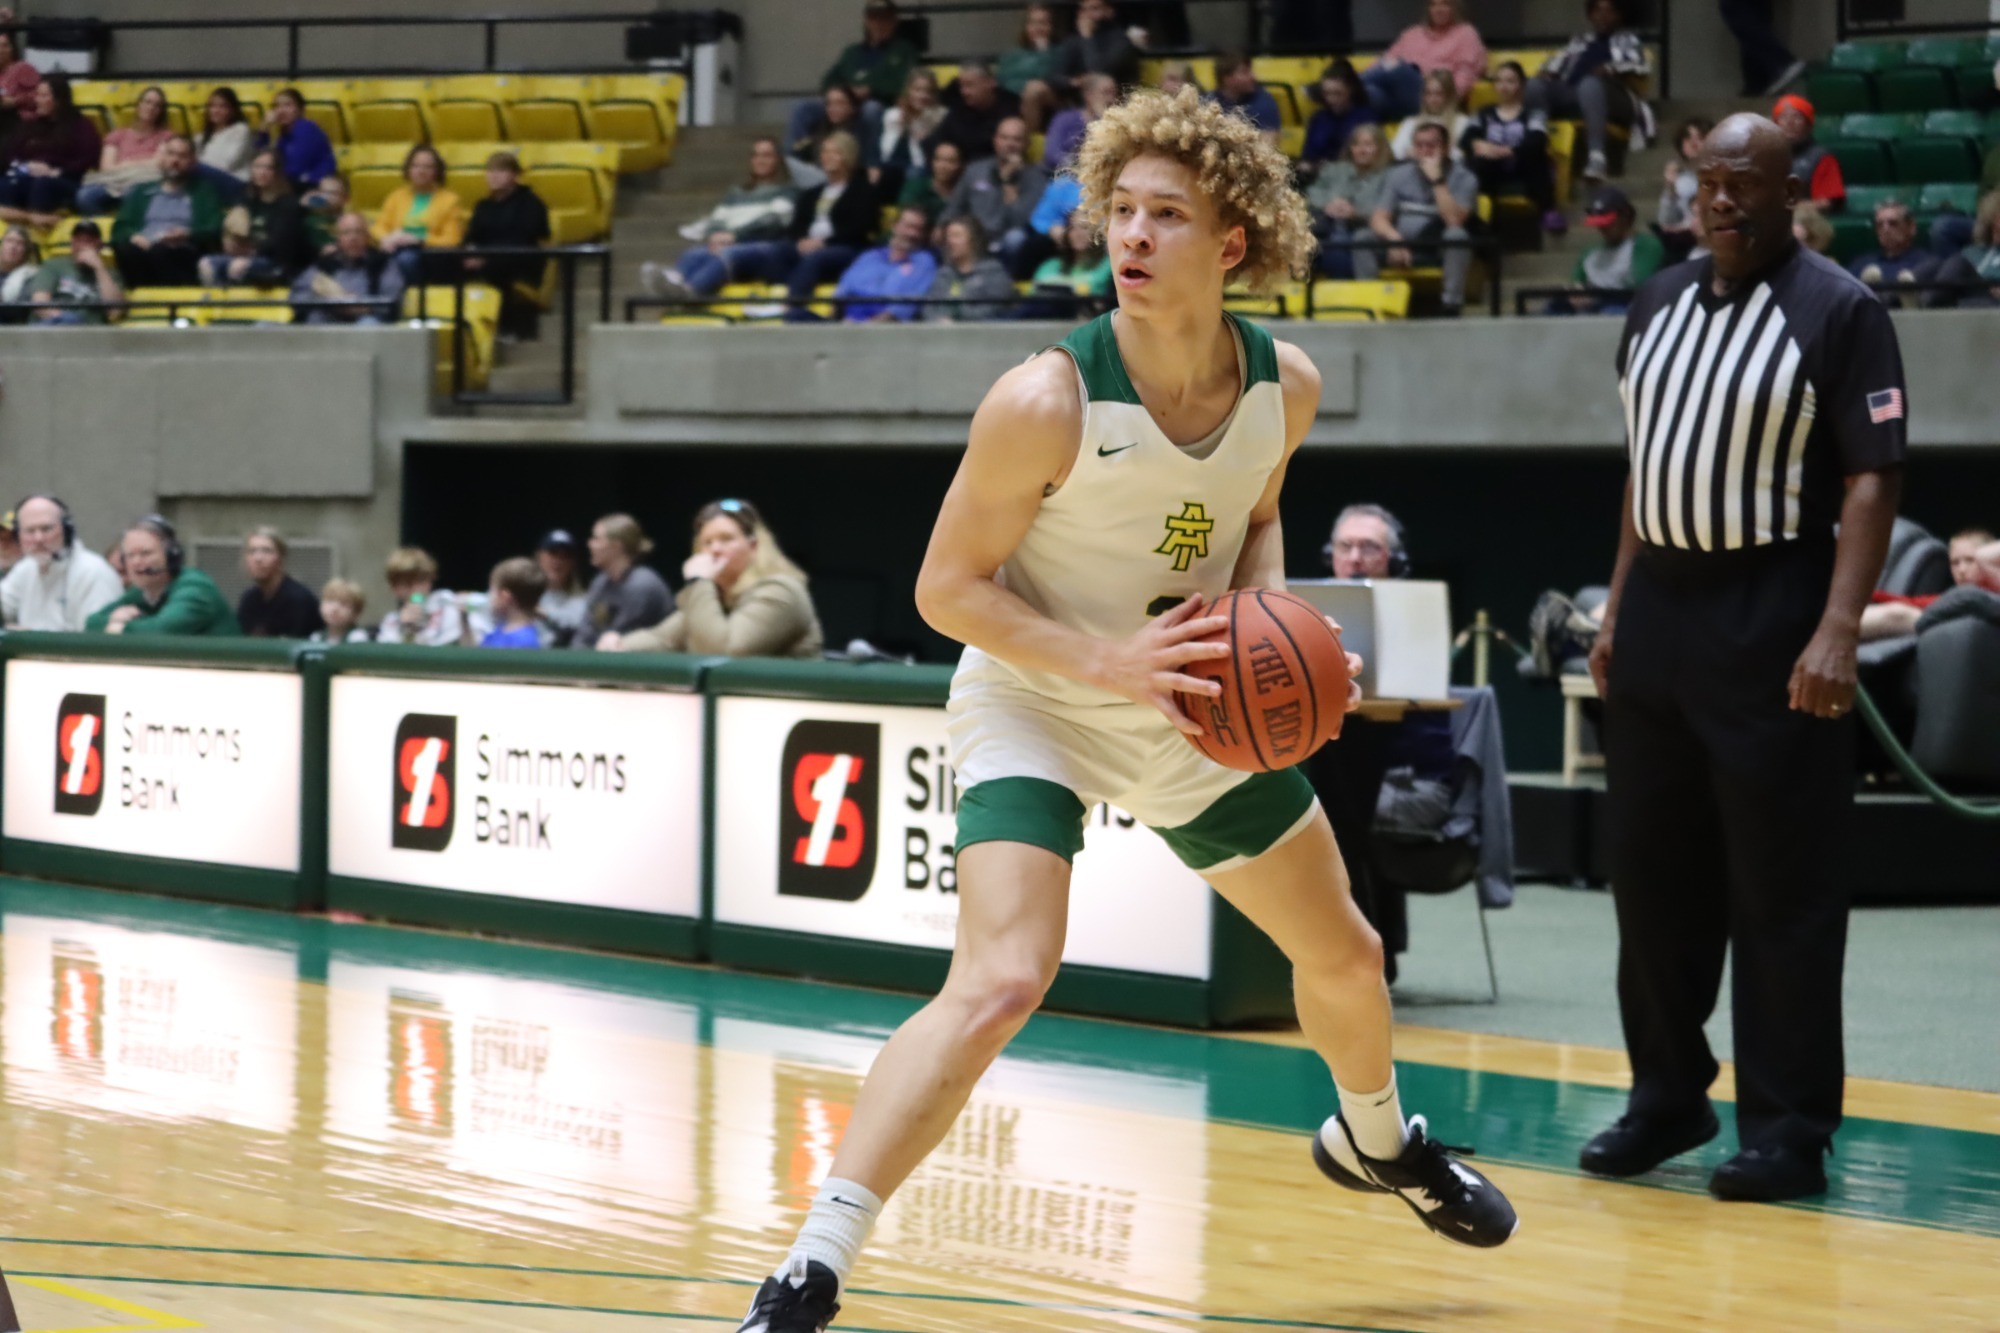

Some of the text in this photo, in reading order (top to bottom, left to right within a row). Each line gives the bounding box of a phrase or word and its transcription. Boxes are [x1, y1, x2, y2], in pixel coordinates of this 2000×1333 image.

[1248, 636, 1302, 757] THE ROCK
[121, 710, 241, 763] Simmons
[476, 733, 627, 793] Simmons
[121, 765, 181, 811] Bank
[475, 795, 552, 850] Bank
[904, 826, 957, 895] Ba
